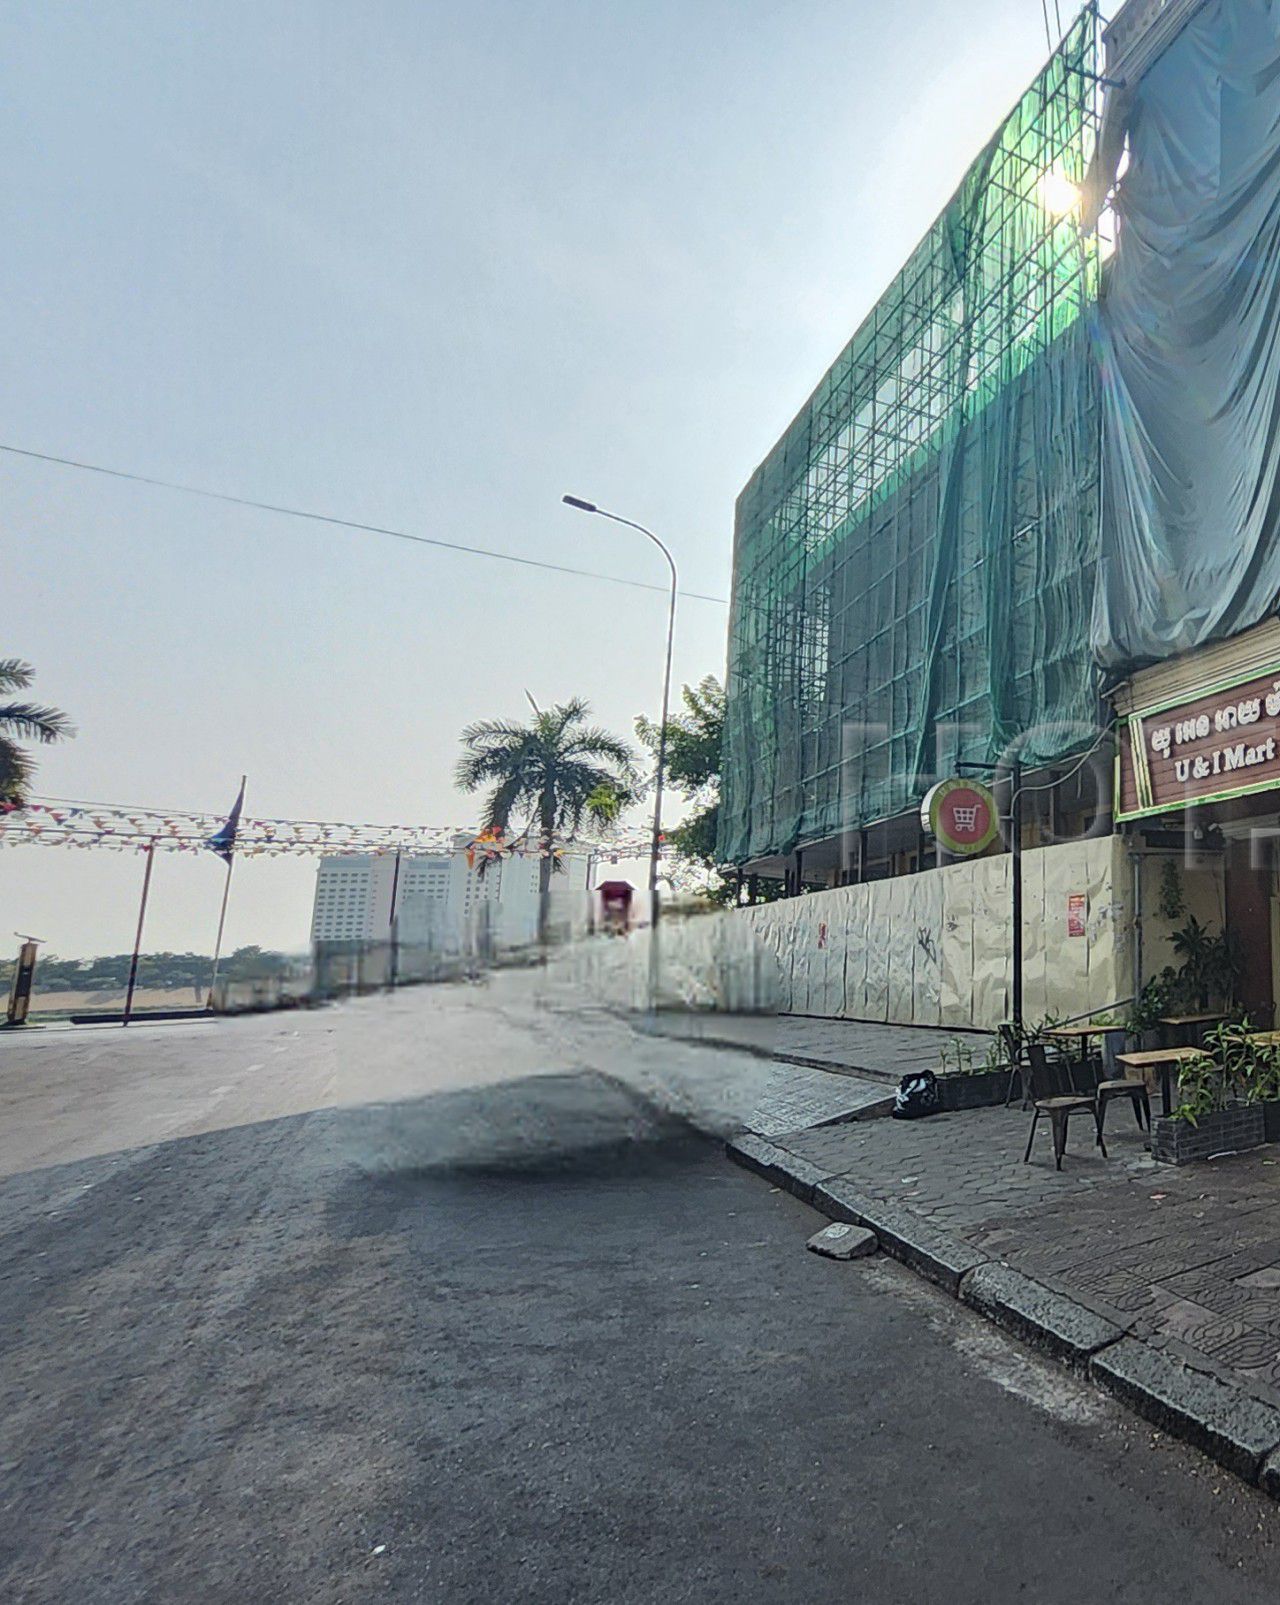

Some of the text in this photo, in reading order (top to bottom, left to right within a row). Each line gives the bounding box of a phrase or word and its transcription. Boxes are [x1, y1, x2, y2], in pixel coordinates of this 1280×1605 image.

[1175, 737, 1275, 782] U & I Mart
